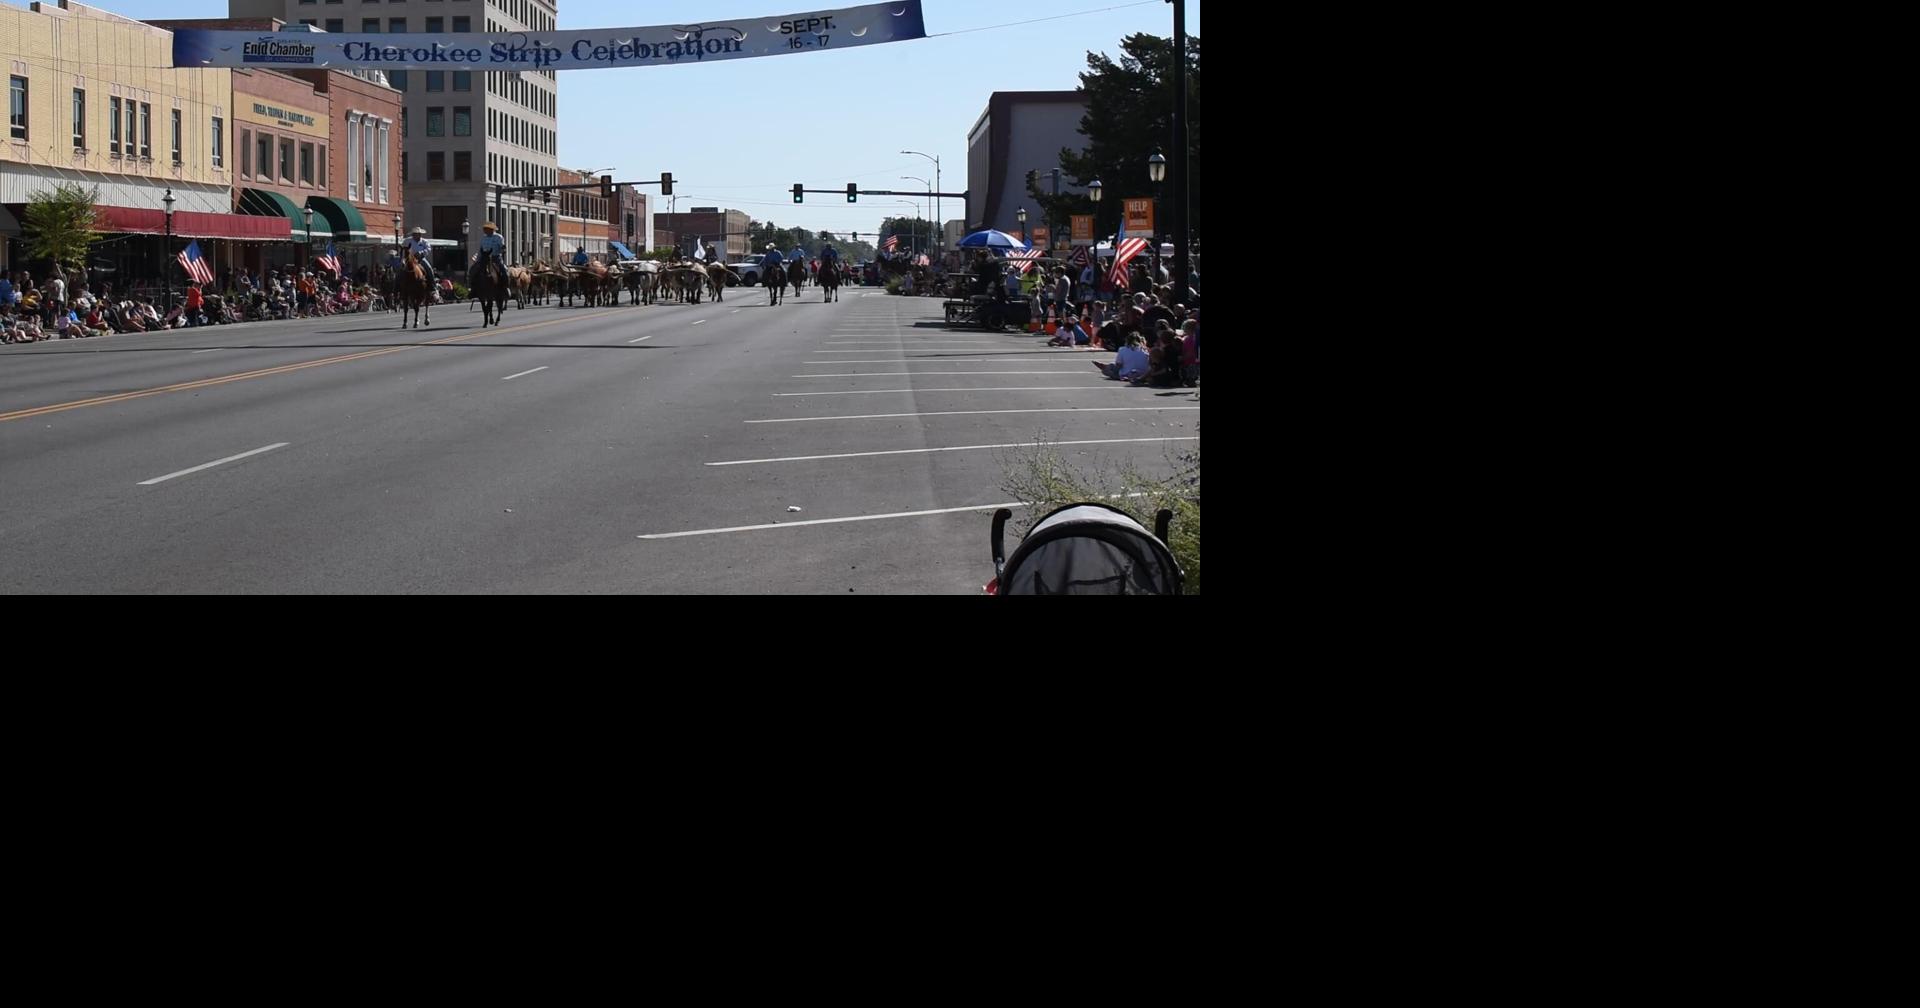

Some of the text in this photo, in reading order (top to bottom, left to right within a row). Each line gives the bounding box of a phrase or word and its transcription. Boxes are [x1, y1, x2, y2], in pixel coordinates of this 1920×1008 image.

[780, 16, 837, 34] SEPT.
[244, 42, 315, 56] Enid Chamber
[343, 27, 743, 68] Cherokee Strip Celebration
[789, 36, 803, 49] 16
[818, 35, 829, 47] 17
[1129, 200, 1147, 211] HELP
